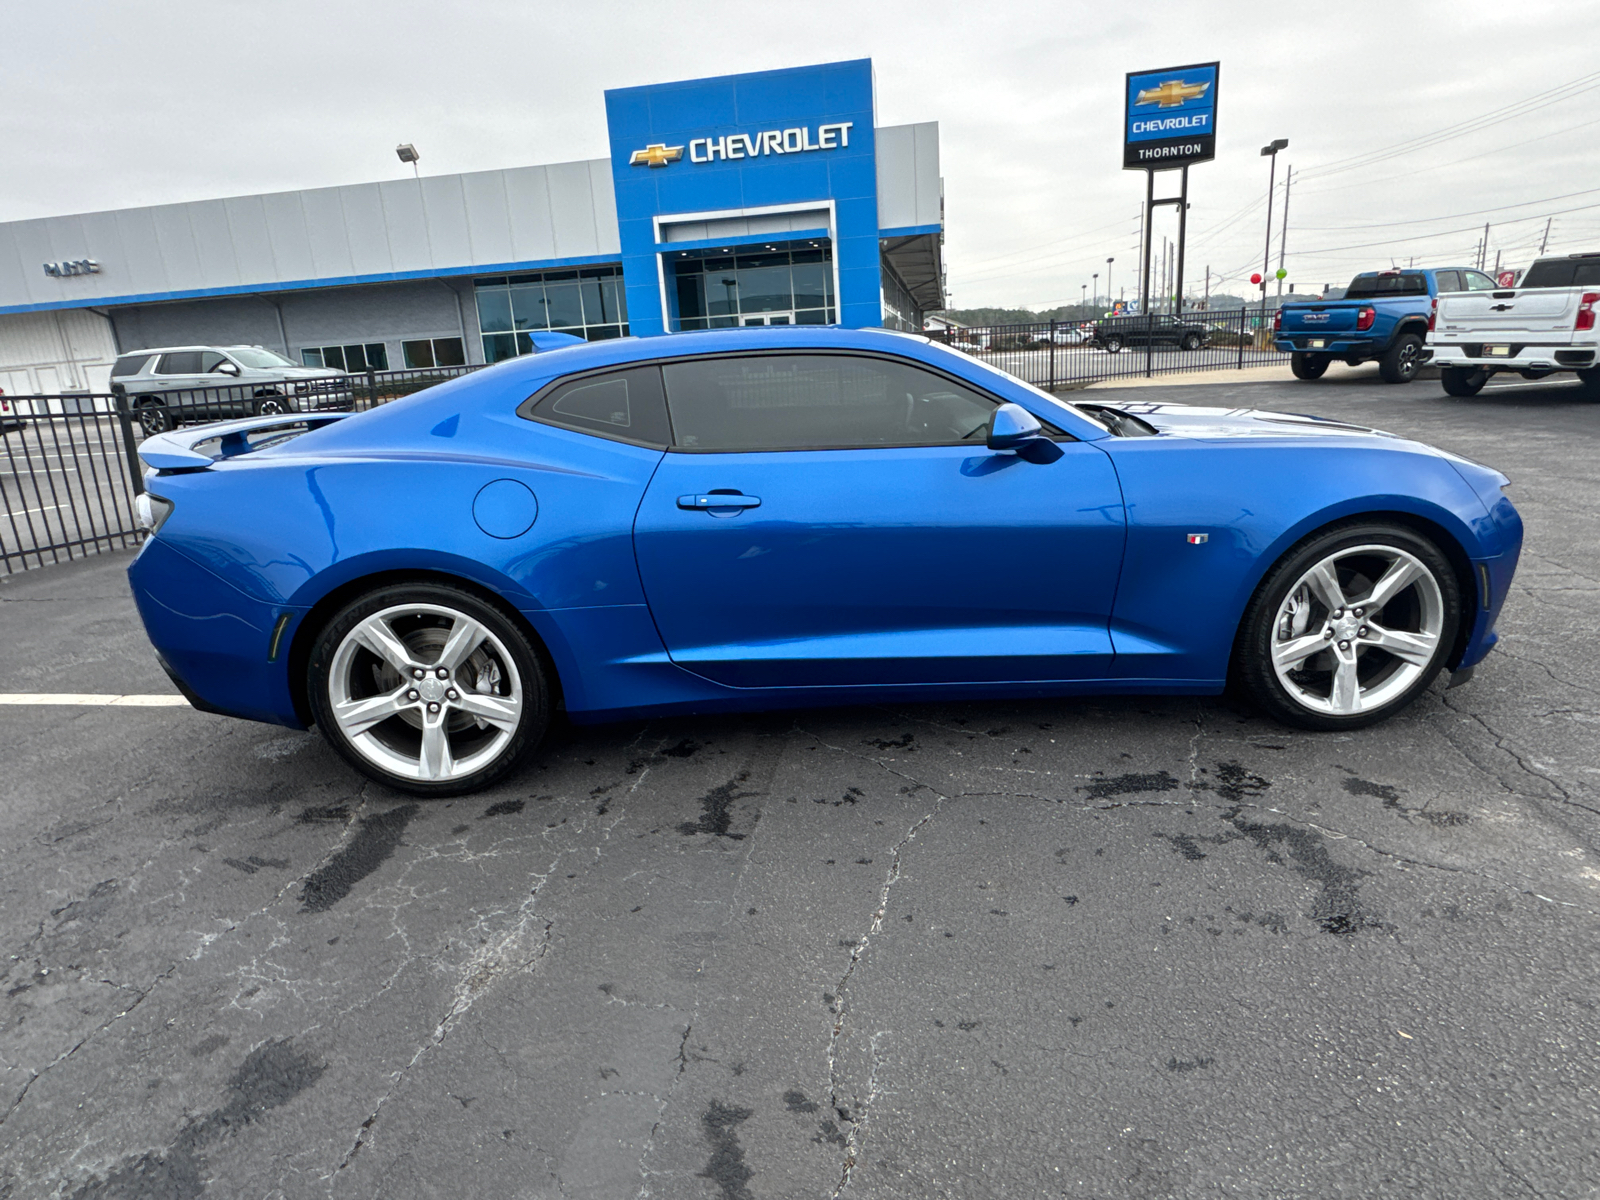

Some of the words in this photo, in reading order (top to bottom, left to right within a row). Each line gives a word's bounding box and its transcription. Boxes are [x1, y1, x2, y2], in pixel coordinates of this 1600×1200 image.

[1132, 114, 1209, 134] CHEVROLET
[689, 121, 854, 164] CHEVROLET
[1138, 143, 1202, 160] THORNTON
